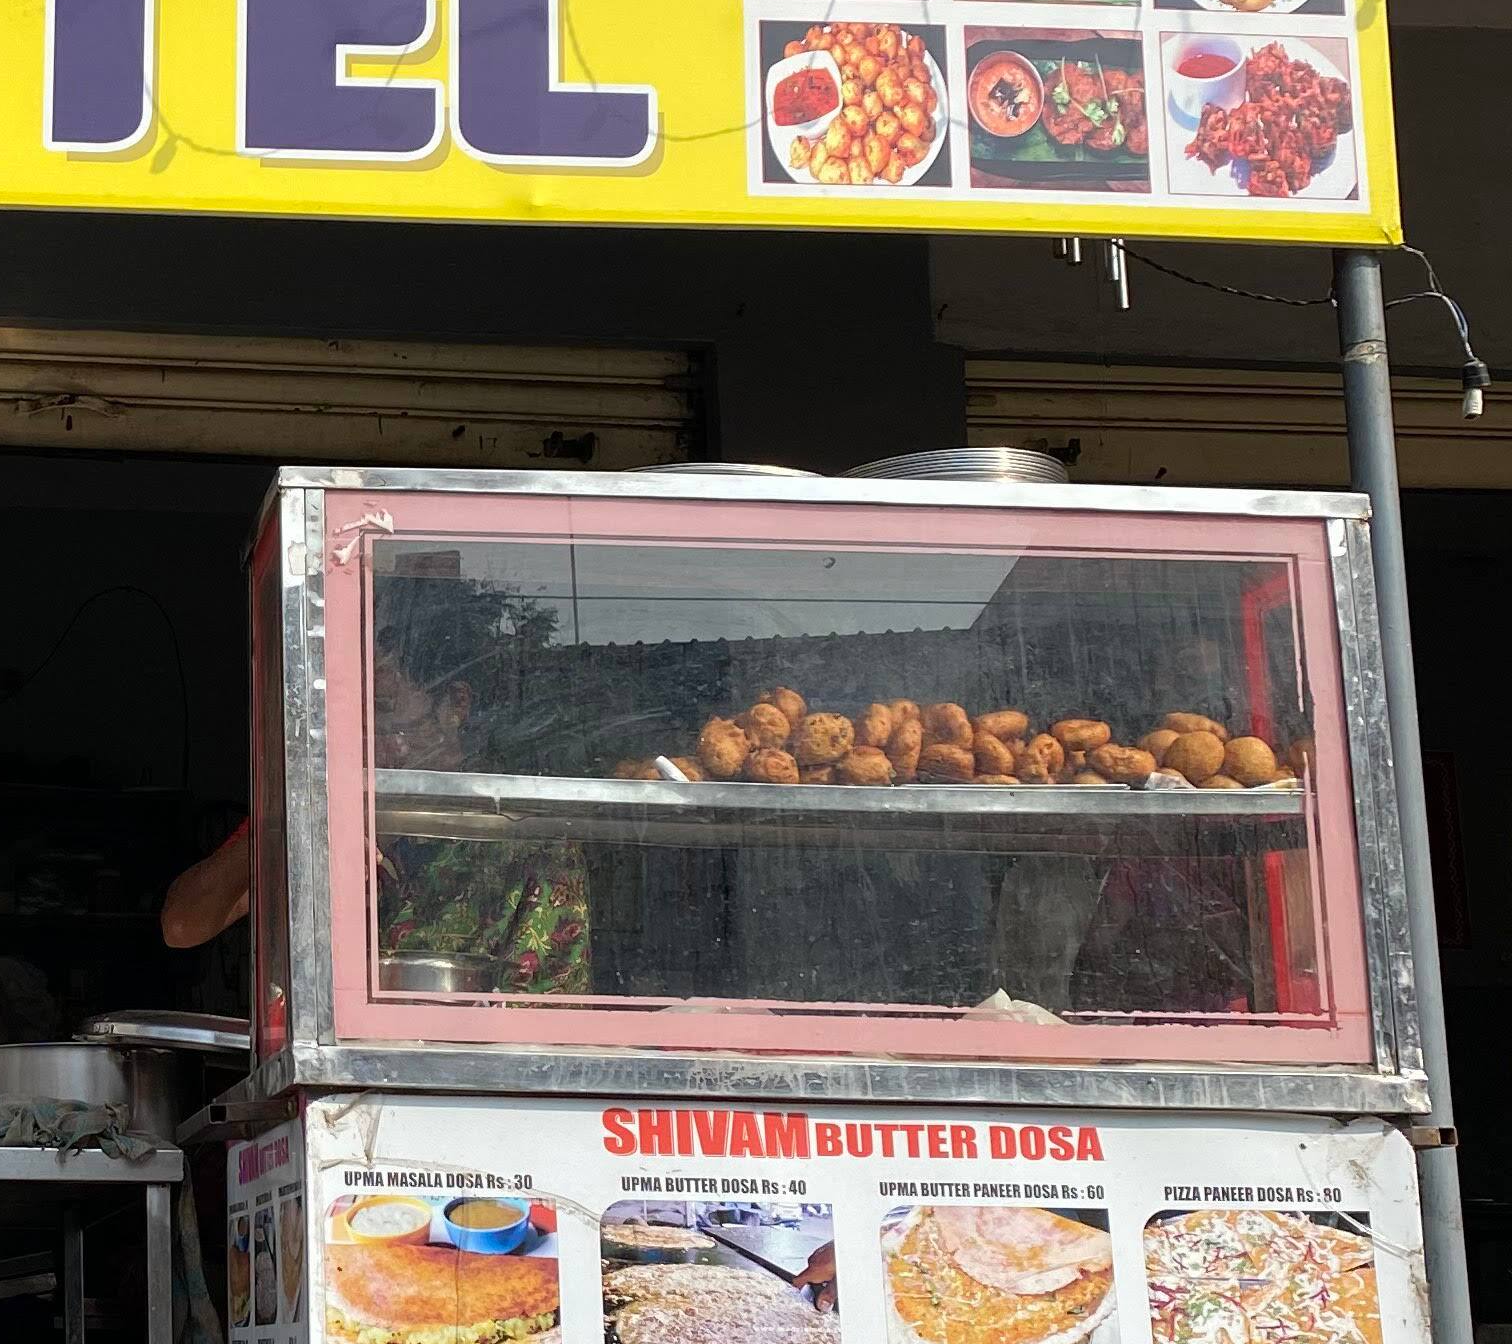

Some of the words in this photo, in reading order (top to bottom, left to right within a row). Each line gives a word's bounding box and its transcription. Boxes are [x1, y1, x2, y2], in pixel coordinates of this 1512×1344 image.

[601, 1107, 811, 1160] SHIVAM
[815, 1122, 978, 1160] BUTTER
[989, 1125, 1106, 1162] DOSA
[344, 1171, 384, 1187] UPMA
[388, 1172, 443, 1188] MASALA
[446, 1173, 484, 1189] DOSA
[621, 1176, 662, 1193] UPMA
[665, 1177, 718, 1194] BUTTER
[721, 1178, 759, 1195] DOSA
[879, 1181, 917, 1197] UPMA
[921, 1182, 971, 1197] BUTTER
[973, 1183, 1021, 1198] PANEER
[1024, 1184, 1059, 1199] DOSA
[1164, 1186, 1201, 1202] PIZZA
[1204, 1186, 1254, 1202] PANEER
[1257, 1187, 1294, 1203] DOSA
